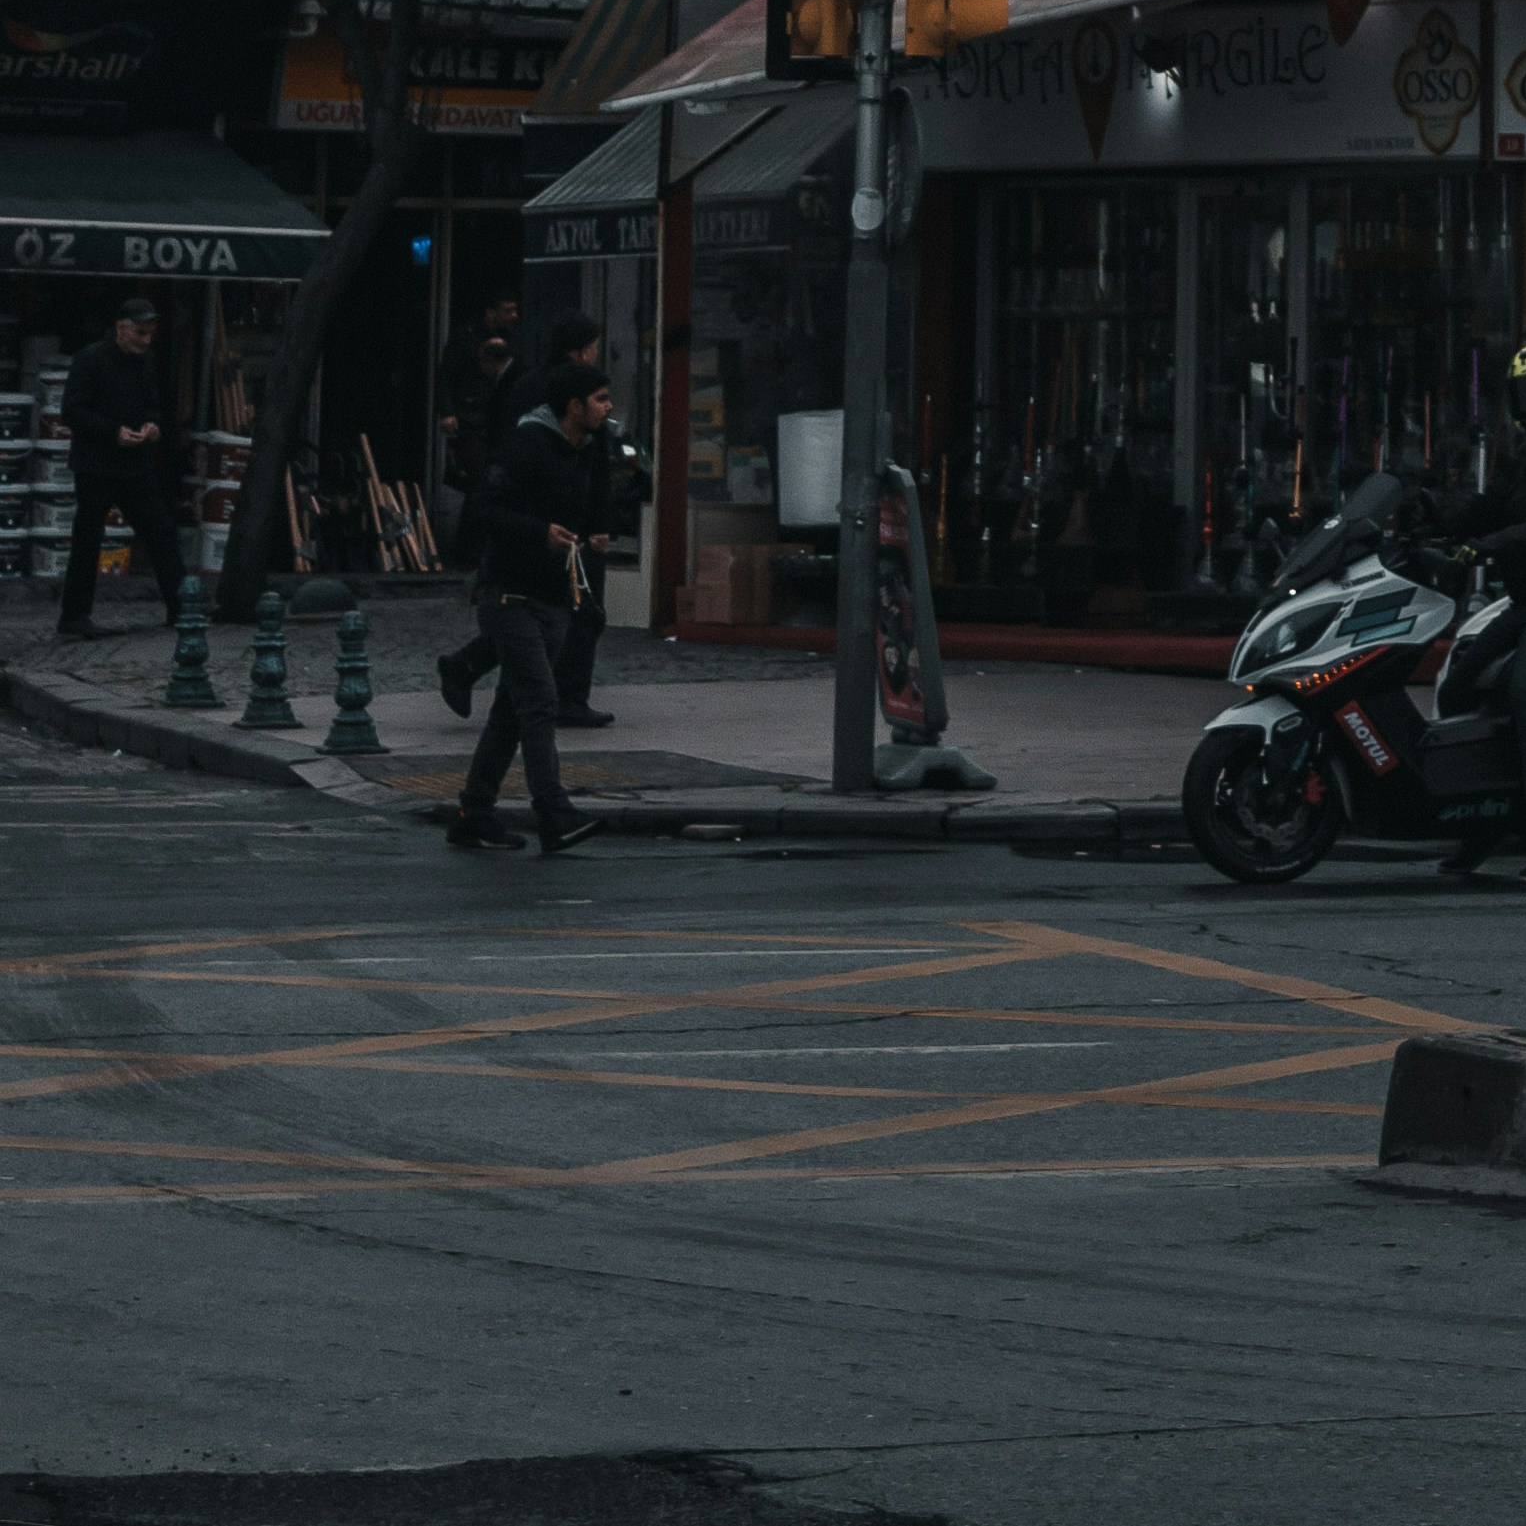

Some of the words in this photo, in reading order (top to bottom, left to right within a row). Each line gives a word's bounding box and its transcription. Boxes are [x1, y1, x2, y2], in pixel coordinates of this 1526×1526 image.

[1403, 68, 1473, 104] OSSO
[14, 228, 76, 267] ÖZ
[123, 236, 239, 273] BOYA
[544, 218, 602, 254] AKYOL
[1342, 710, 1391, 768] MOTUL
